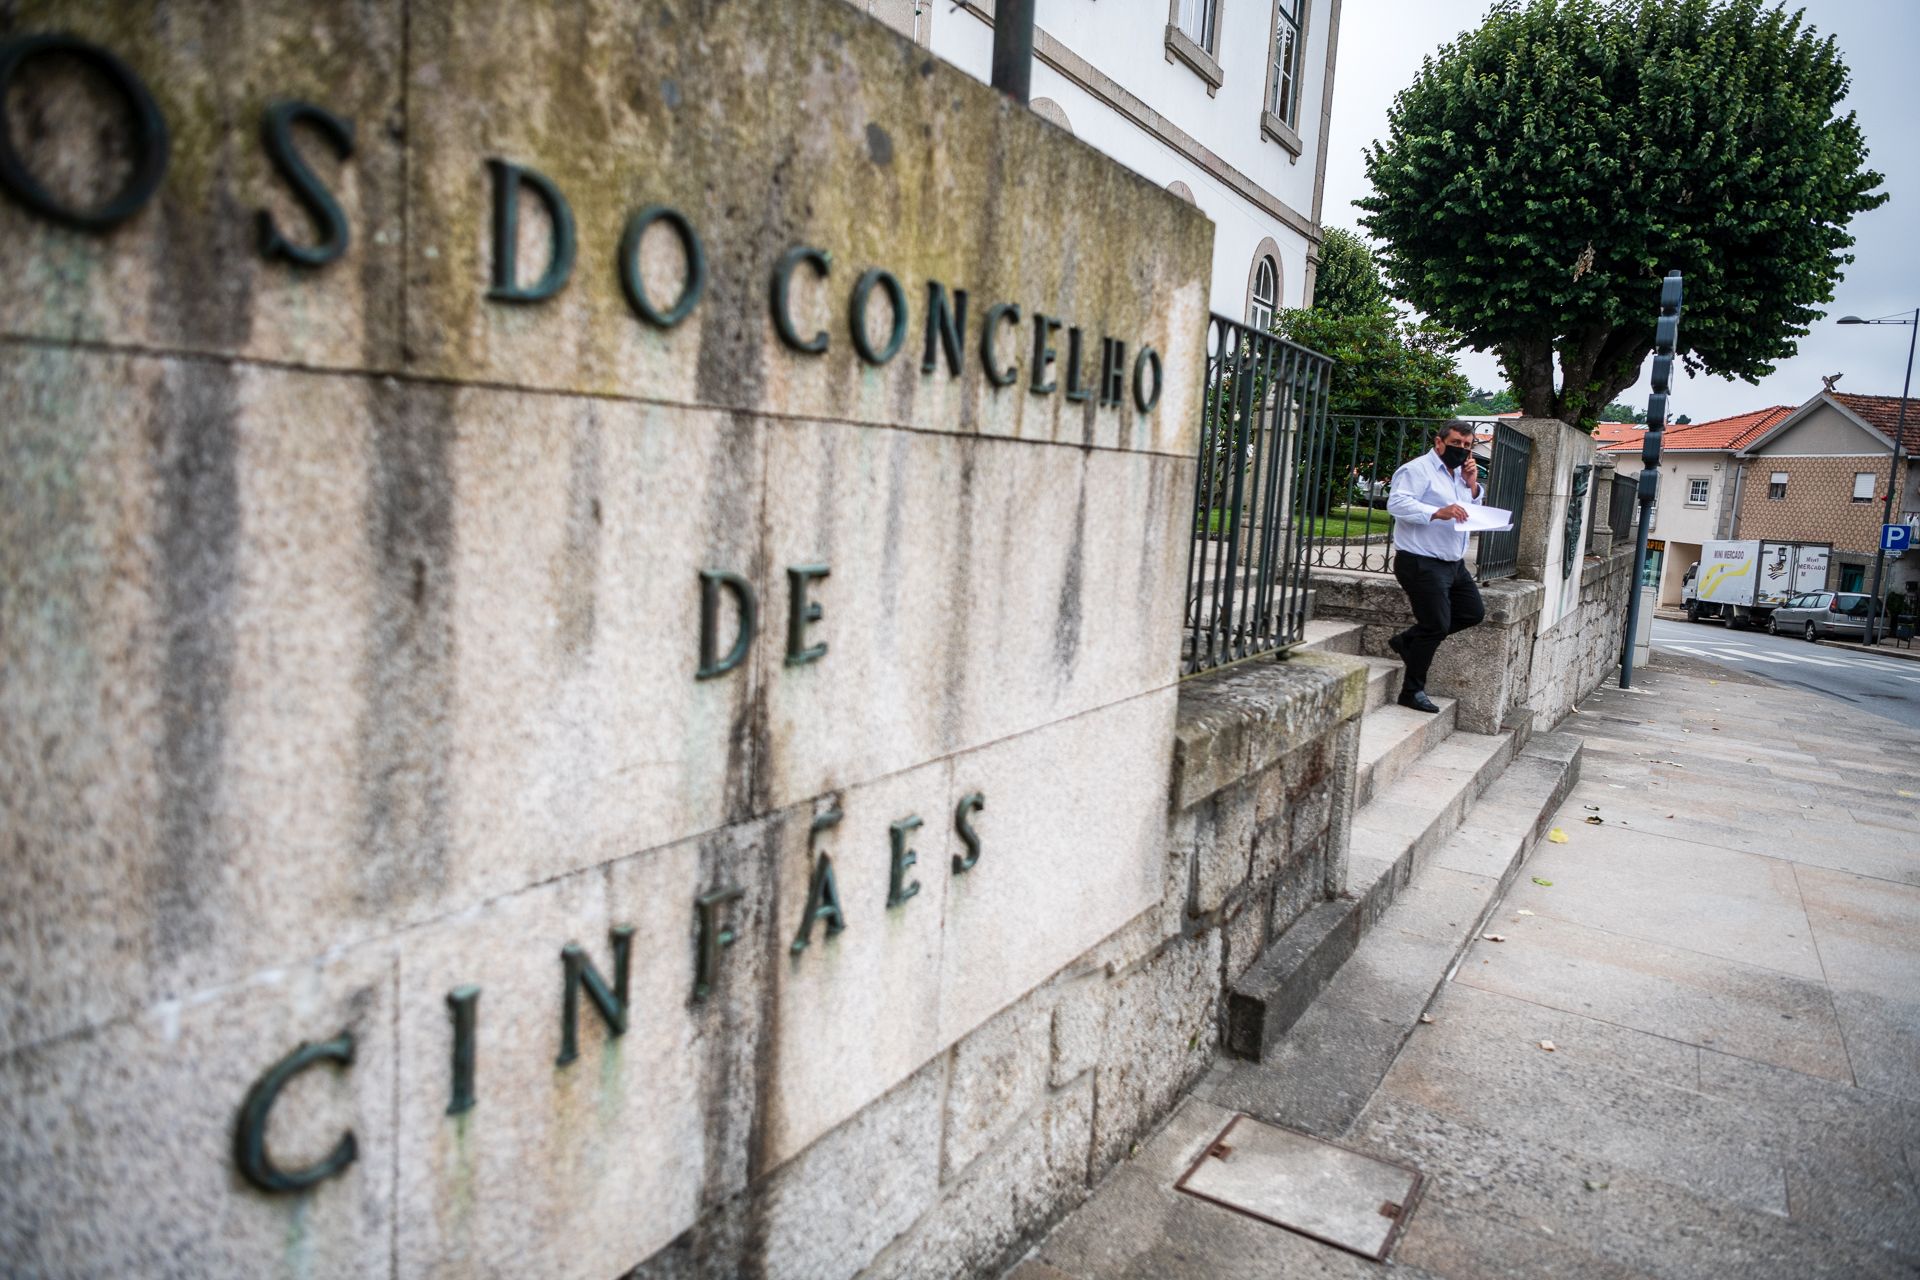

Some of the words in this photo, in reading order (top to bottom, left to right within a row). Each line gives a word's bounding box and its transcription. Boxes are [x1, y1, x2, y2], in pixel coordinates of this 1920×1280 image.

[485, 158, 706, 328] DO
[770, 245, 1163, 413] CONCELHO
[1724, 550, 1744, 560] MERCADO
[1798, 563, 1826, 571] MERCADO
[1886, 526, 1905, 548] P
[695, 564, 830, 682] DE
[231, 791, 985, 1194] CINFÃES
